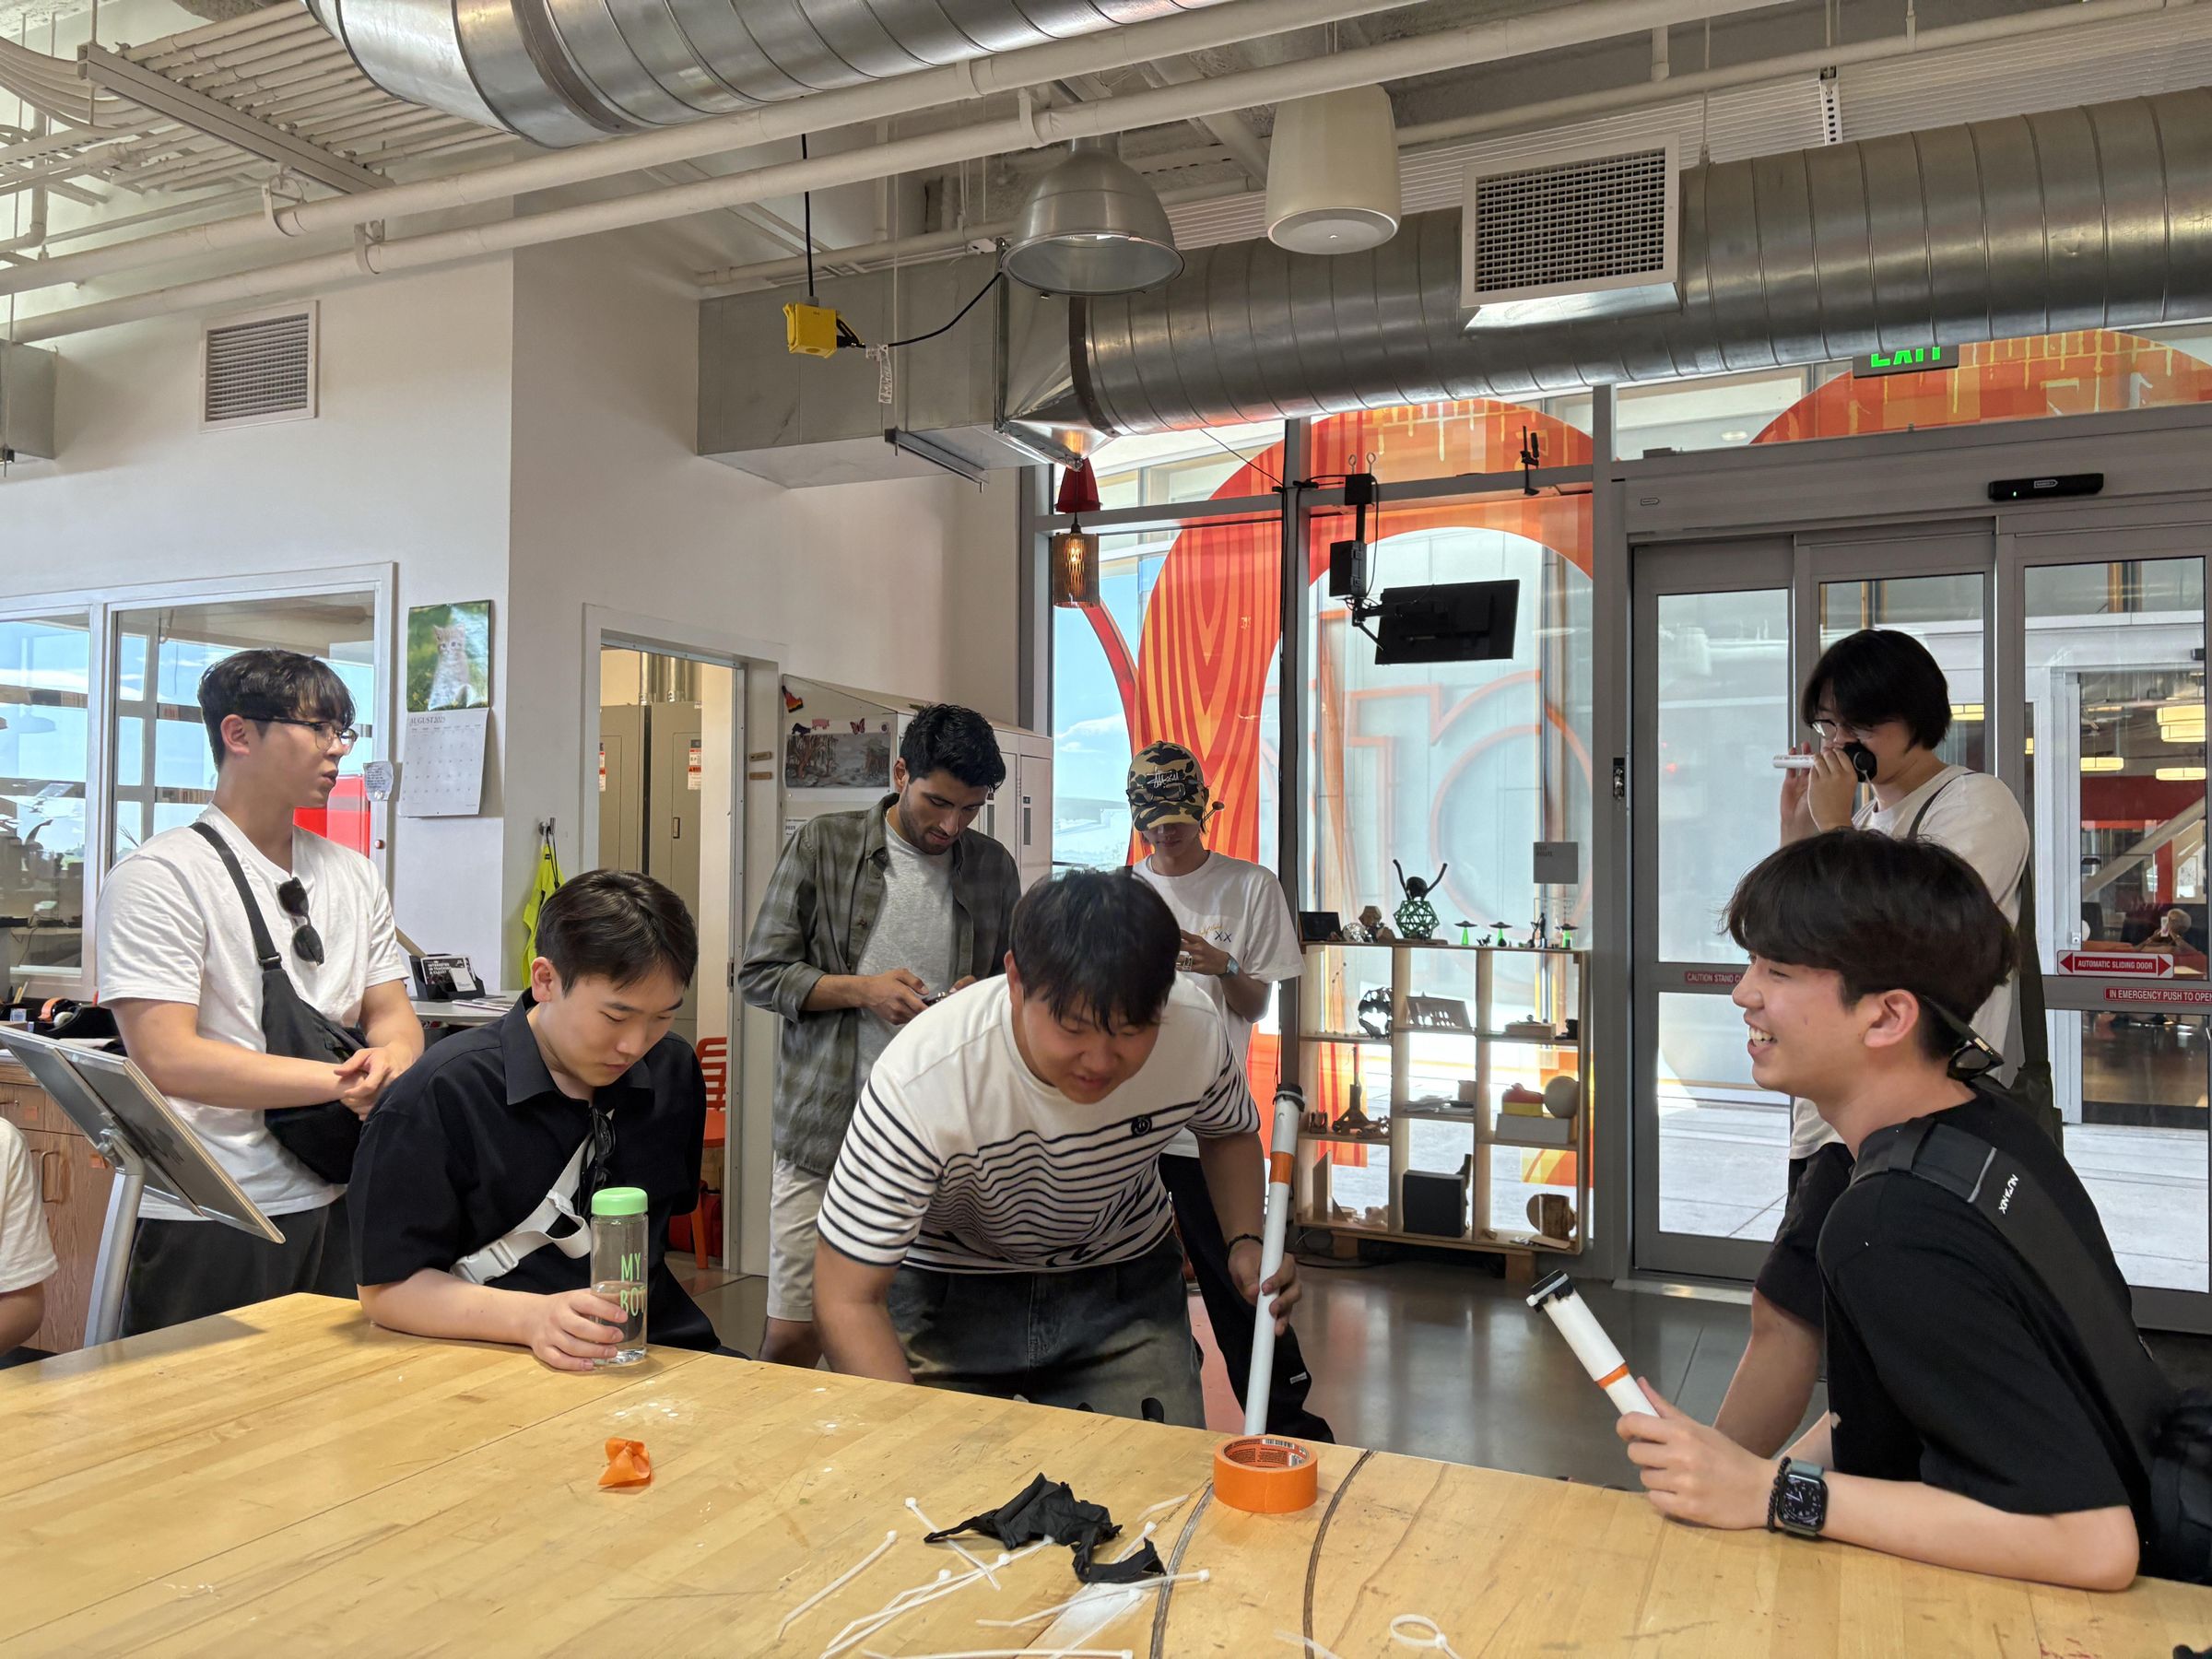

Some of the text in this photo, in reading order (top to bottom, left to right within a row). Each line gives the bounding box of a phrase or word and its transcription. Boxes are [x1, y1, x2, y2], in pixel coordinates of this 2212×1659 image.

[2077, 959, 2153, 970] AUTOMATIC SLIDING DOOR
[1687, 972, 1712, 982] CAUTION
[1713, 973, 1734, 982] STAND
[2109, 989, 2116, 998] IN
[2118, 989, 2161, 1000] EMERGENCY
[2162, 991, 2183, 1001] PUSH
[2184, 992, 2194, 1001] TO
[620, 1252, 641, 1283] MY
